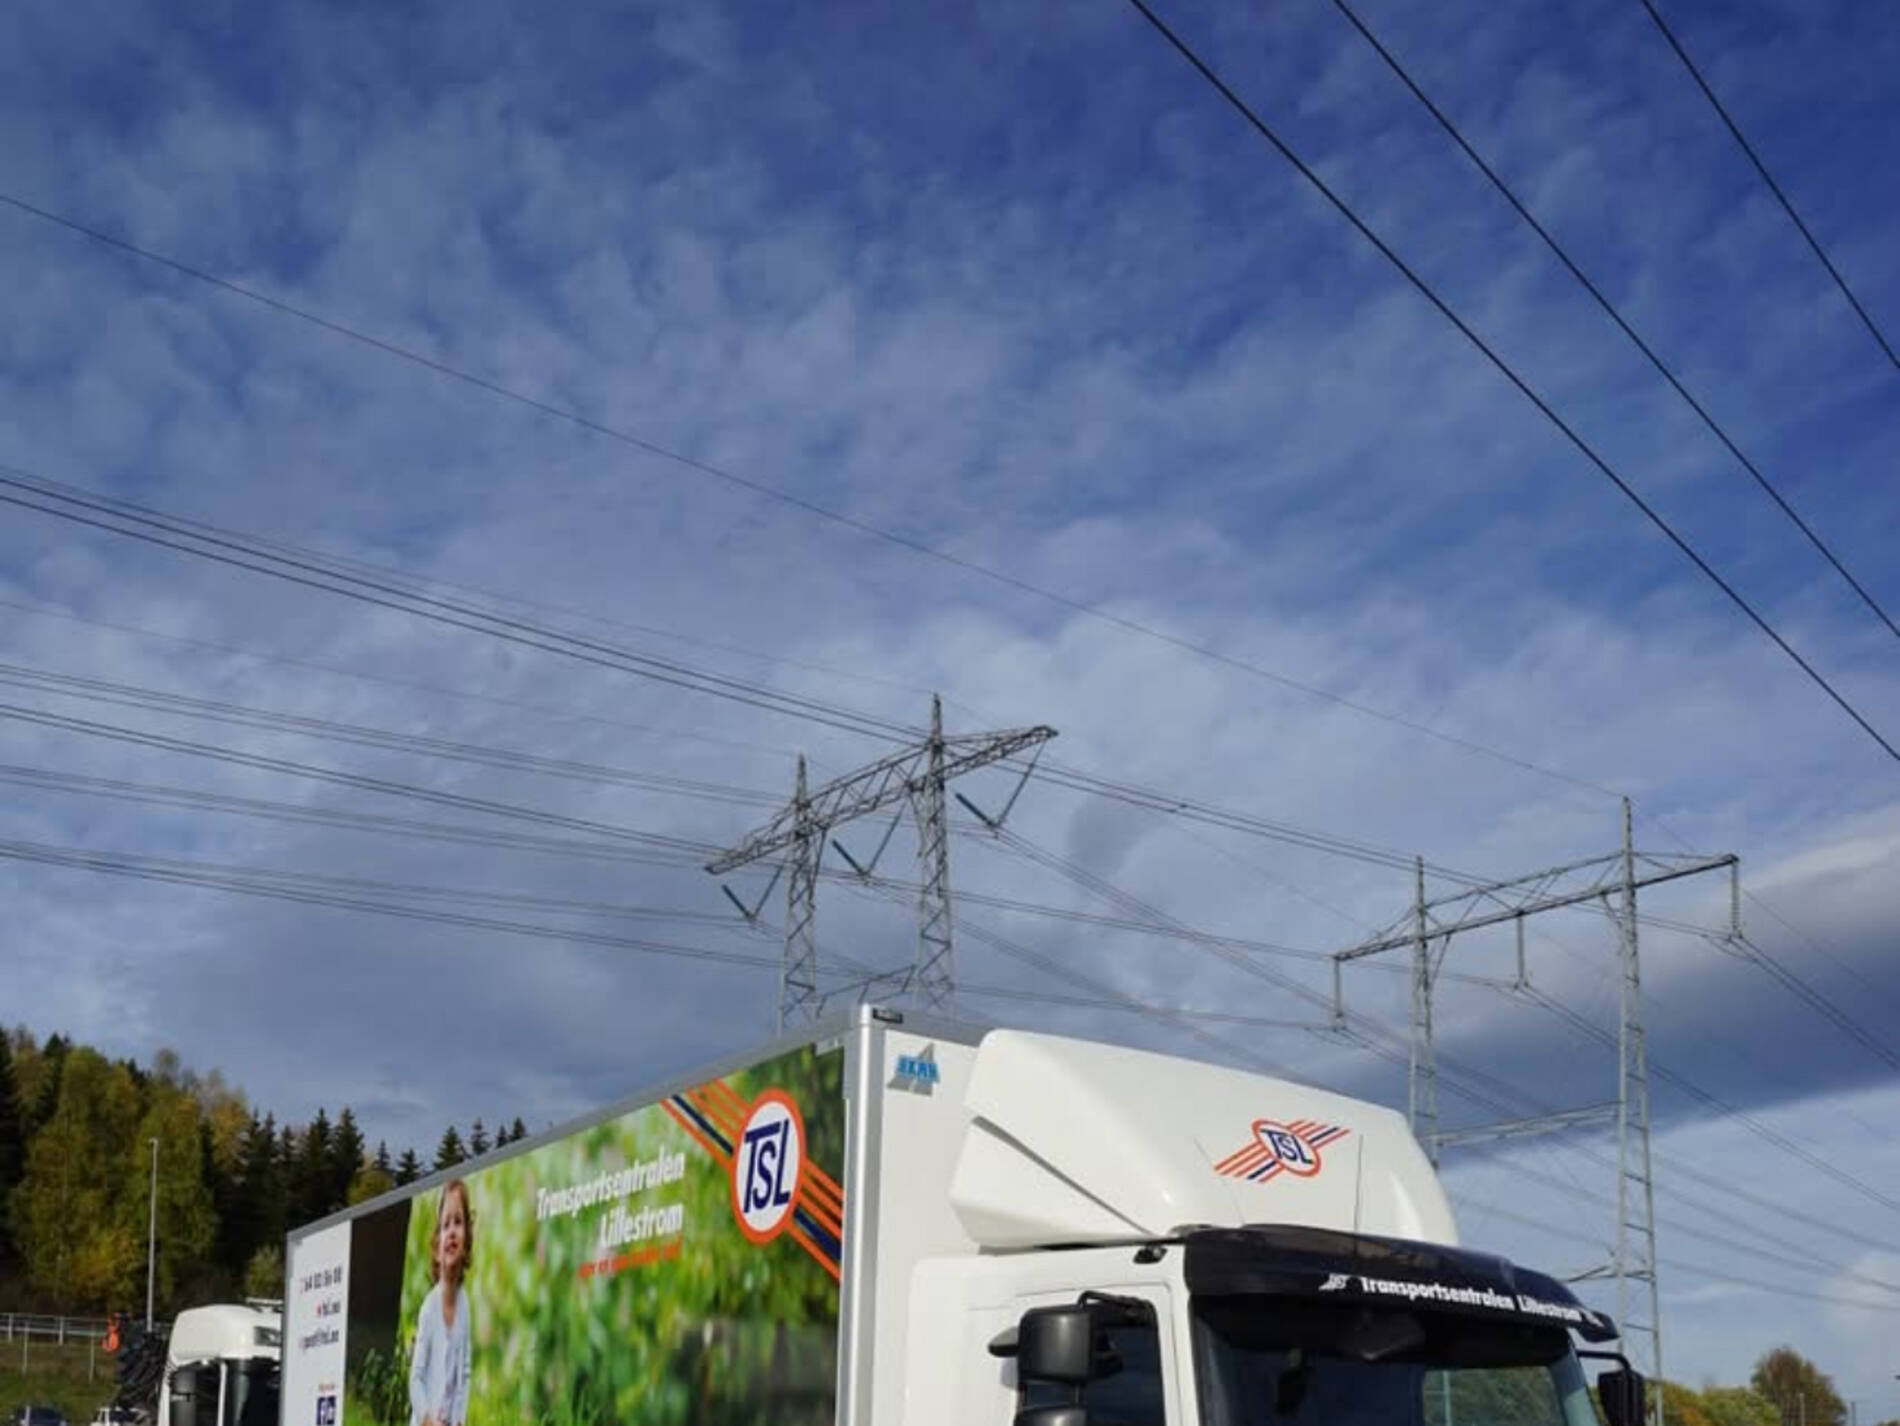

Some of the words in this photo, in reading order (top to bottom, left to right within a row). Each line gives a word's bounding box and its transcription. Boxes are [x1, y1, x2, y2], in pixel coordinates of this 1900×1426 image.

[743, 1118, 791, 1214] TSL
[1259, 1128, 1315, 1165] TSL
[537, 1144, 686, 1222] Transportsentralen
[1360, 1276, 1516, 1311] Transportsentralen
